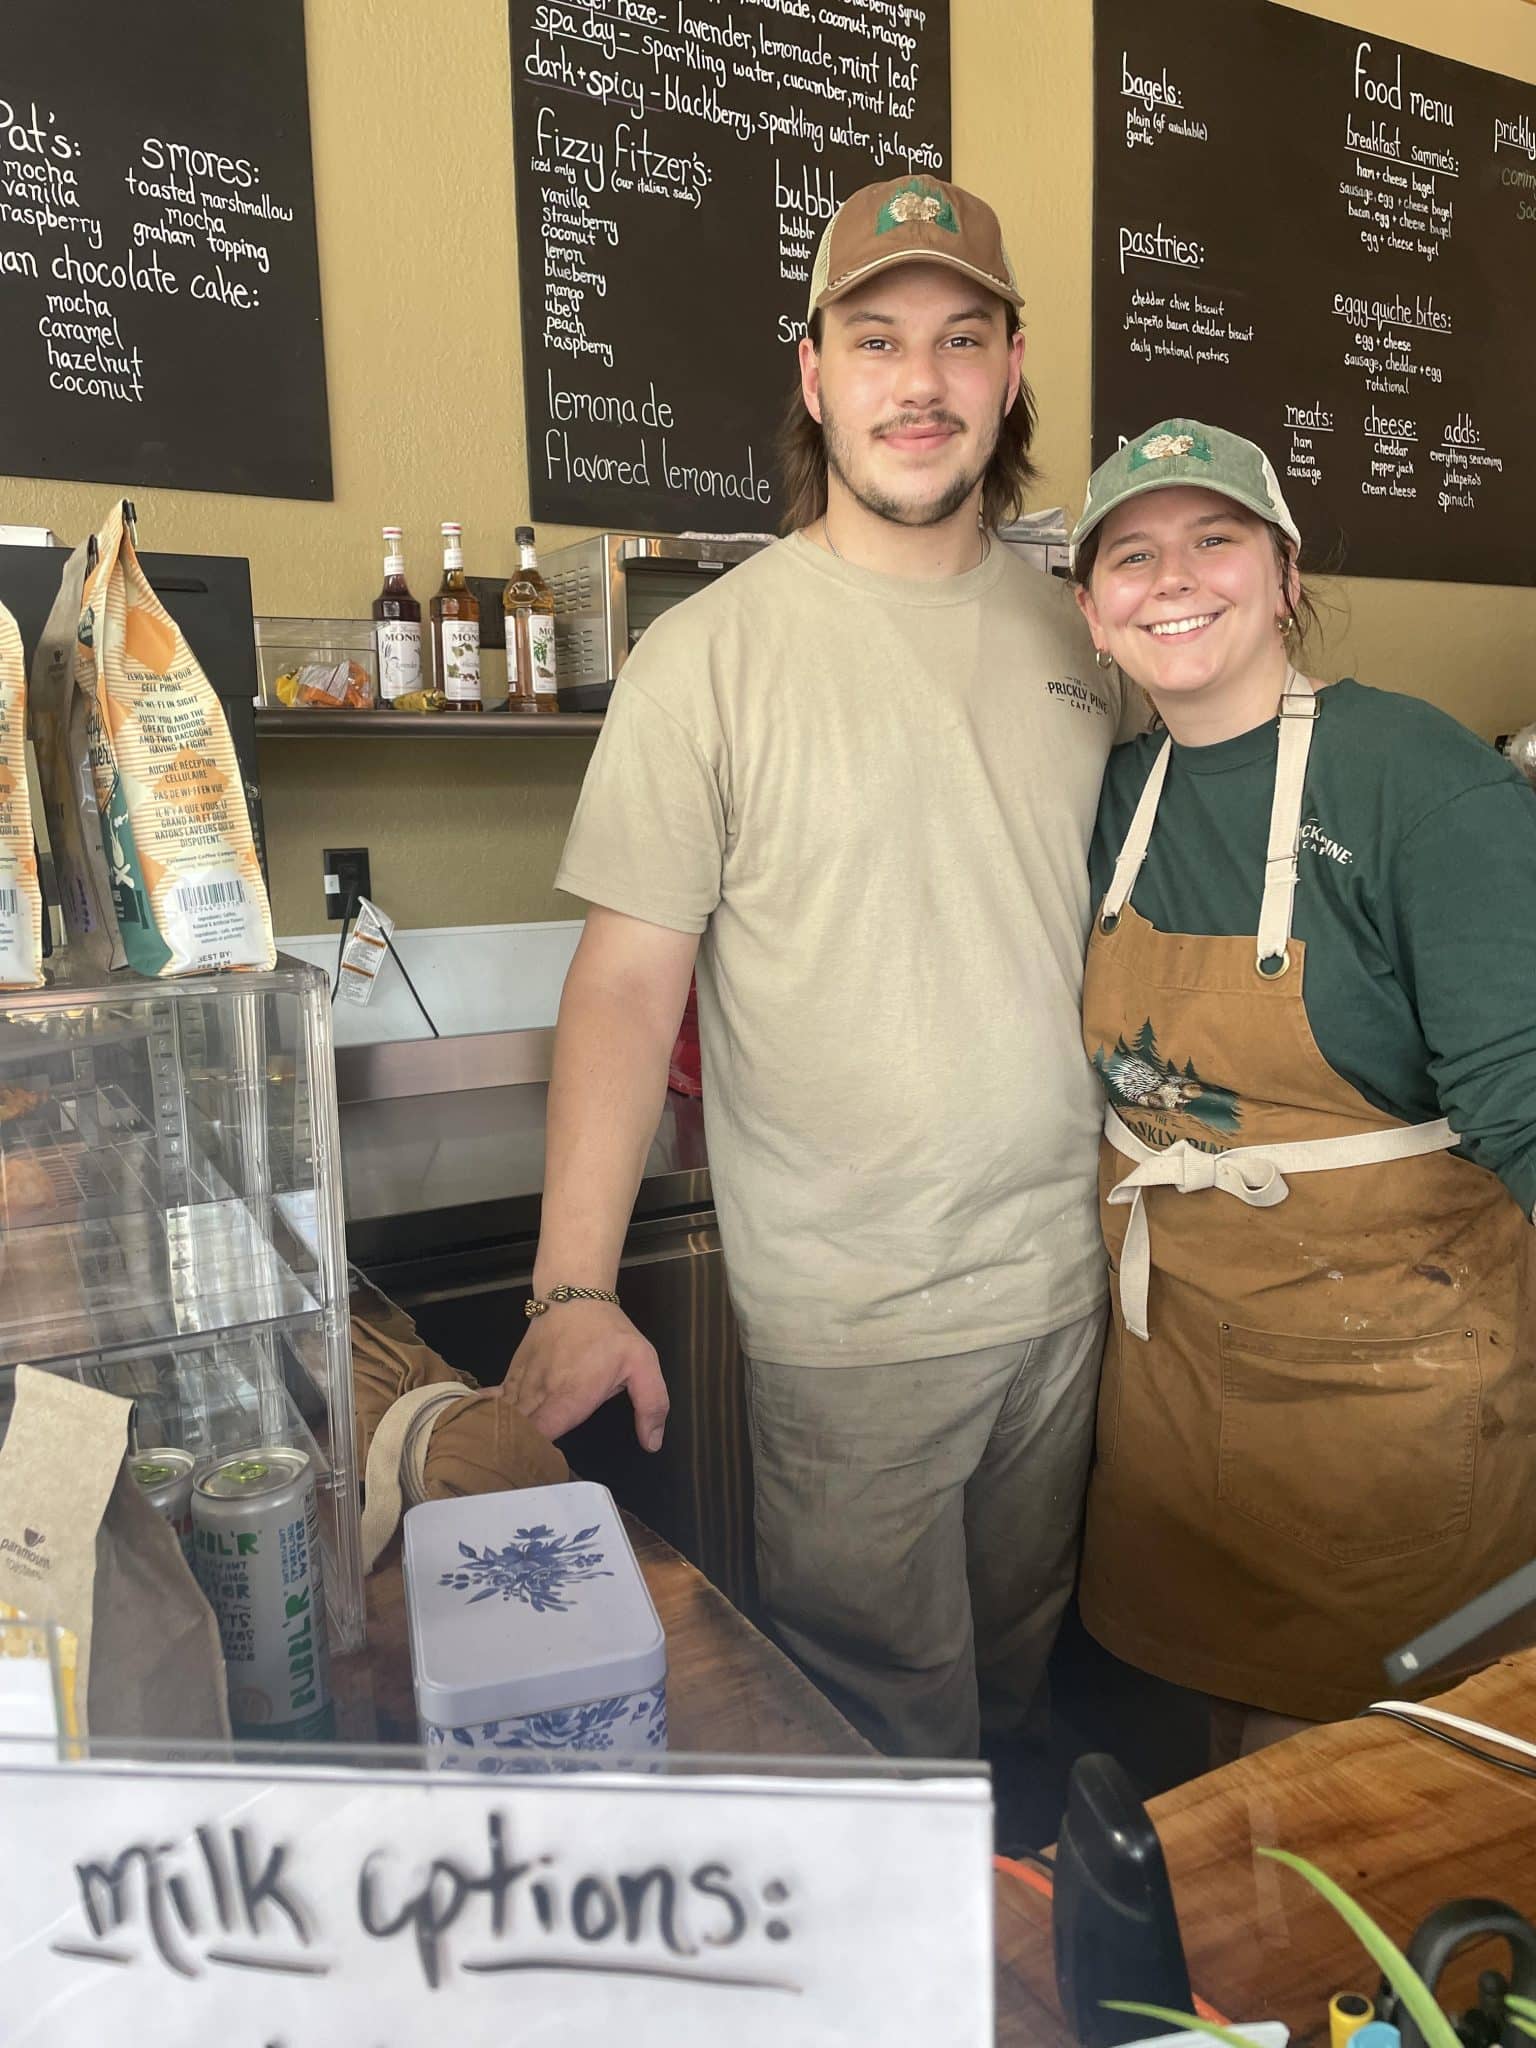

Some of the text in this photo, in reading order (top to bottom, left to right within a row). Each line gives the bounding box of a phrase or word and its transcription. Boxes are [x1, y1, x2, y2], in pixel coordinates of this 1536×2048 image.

[897, 4, 926, 31] syrup
[678, 1, 756, 58] lavender,
[759, 23, 837, 75] lemonade,
[839, 52, 880, 84] mint
[887, 56, 919, 91] leaf
[872, 24, 917, 61] mango
[535, 6, 577, 40] spa
[641, 35, 727, 88] sparkling
[733, 61, 781, 91] water,
[783, 73, 852, 109] cucumber,
[852, 90, 884, 114] mint
[889, 92, 916, 120] leaf
[1123, 51, 1182, 111] bagels:
[1127, 107, 1151, 129] plain
[1153, 112, 1166, 133] (gf
[1410, 91, 1454, 127] menu
[0, 100, 81, 158] Pat's:
[758, 105, 824, 153] sparkling
[829, 117, 874, 153] water,
[874, 131, 943, 173] jalapeño
[1126, 127, 1154, 148] garlic
[1346, 113, 1401, 158] breakfast
[1494, 114, 1536, 160] prickly
[4, 158, 78, 184] mocha
[531, 156, 577, 185] iced only
[1, 179, 80, 207] vanilla
[125, 167, 293, 221] toasted marshmallow
[541, 187, 591, 209] vanilla
[611, 169, 701, 209] (our italian soda)
[1412, 171, 1435, 199] bagel
[165, 207, 226, 234] mocha
[1432, 198, 1453, 223] bagel
[0, 203, 102, 249] raspberry
[779, 213, 815, 240] bubblr
[1400, 211, 1426, 232] cheese
[1430, 218, 1451, 241] bagel
[133, 218, 269, 273] graham topping
[545, 238, 586, 265] lemon
[779, 240, 812, 259] bubblr
[1120, 222, 1204, 275] pastries:
[1360, 230, 1439, 262] egg cheese bagel
[52, 244, 178, 293] chocolate
[190, 265, 259, 308] cake:
[545, 258, 607, 297] blueberry
[780, 260, 809, 282] bubblr
[46, 290, 112, 317] mocha
[545, 283, 584, 313] mango
[545, 296, 572, 317] ube
[1131, 288, 1225, 316] cheddar chive biscuit
[547, 314, 587, 337] peach
[1123, 311, 1255, 341] jalapeño bacon cheddar biscuit
[1334, 293, 1452, 332] eggy quiche bites:
[543, 333, 614, 368] raspberry
[1130, 338, 1230, 365] daily rotational pastries
[1355, 331, 1412, 352] egg cheese
[47, 339, 143, 376] hazelnut
[1385, 351, 1418, 374] cheddar
[1425, 365, 1442, 383] egg
[548, 368, 674, 429] lemonade
[1365, 375, 1409, 394] rotational
[1285, 400, 1333, 427] meats:
[1364, 404, 1417, 437] cheese:
[1293, 431, 1313, 449] ham
[1374, 438, 1409, 457] cheddar
[1290, 447, 1315, 465] bacon
[1371, 460, 1414, 479] pepper jack
[1429, 447, 1468, 470] everything
[662, 437, 771, 504] lemonade
[1286, 465, 1322, 486] sausage
[1389, 479, 1417, 498] cheese
[176, 695, 198, 705] SIGHT
[1048, 681, 1088, 701] PRICKLY
[174, 713, 189, 723] AND
